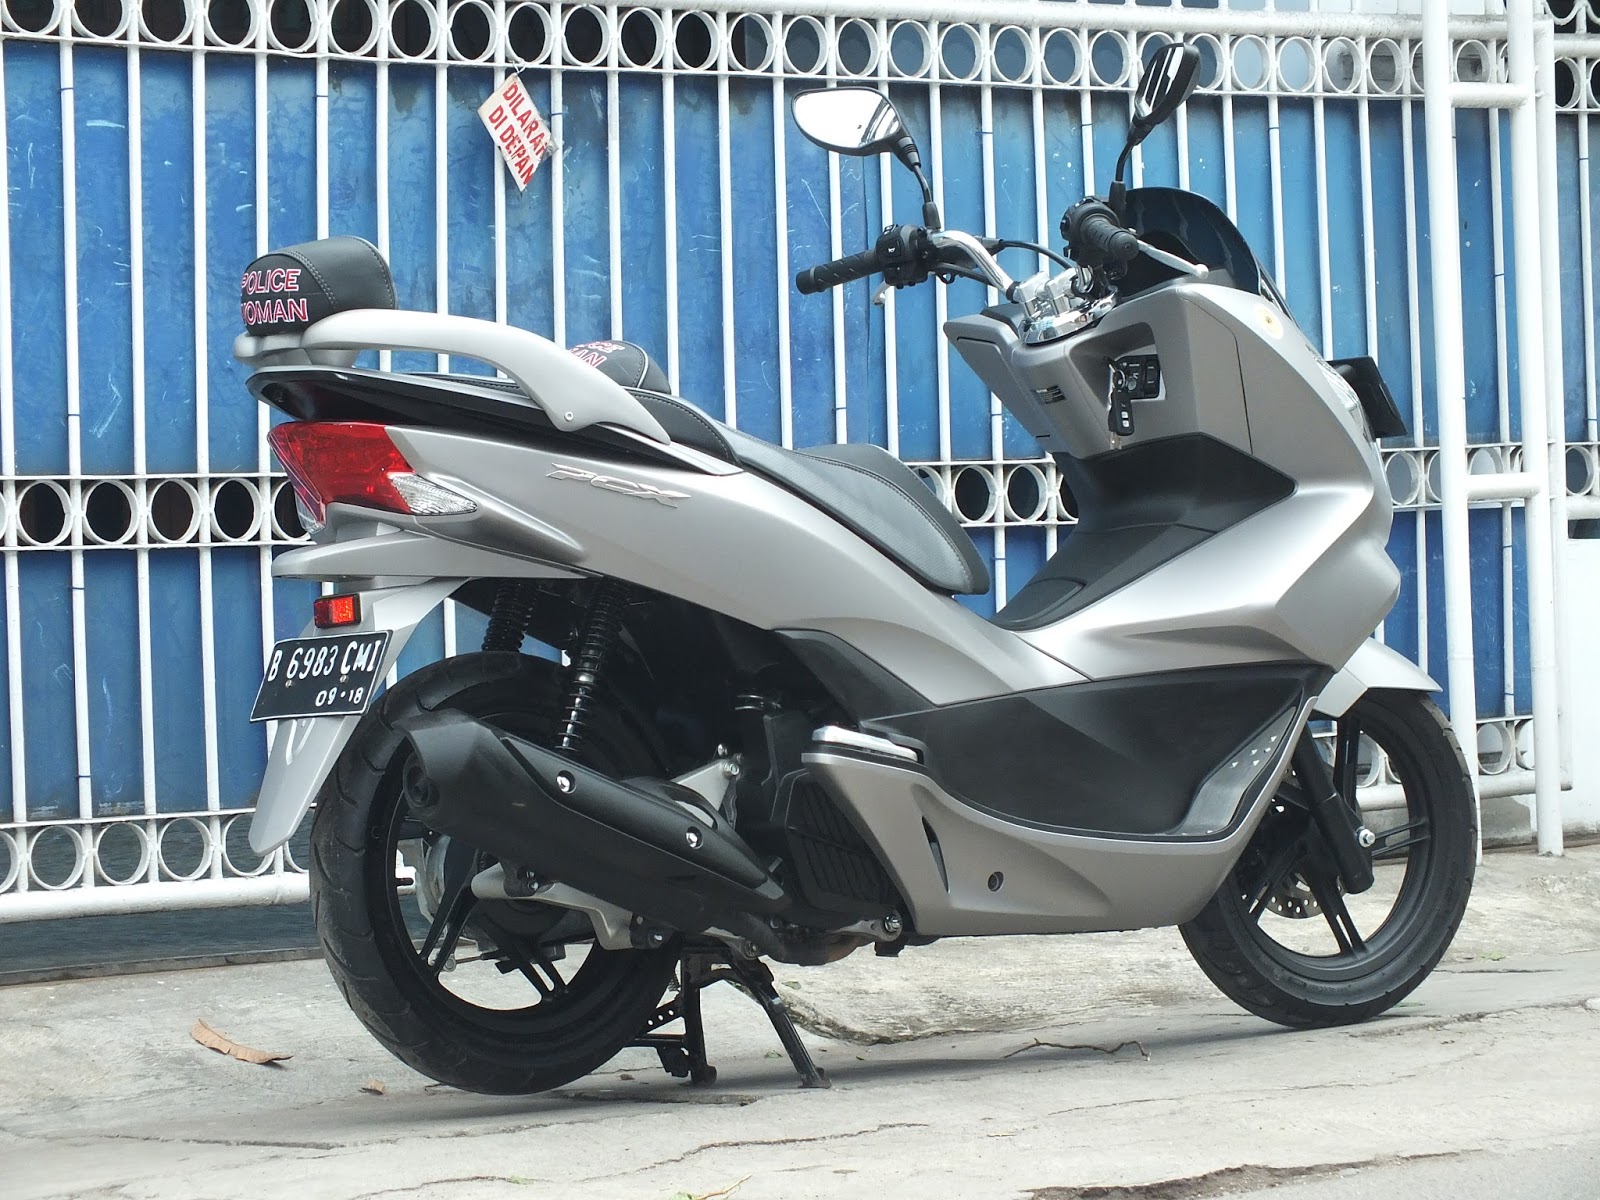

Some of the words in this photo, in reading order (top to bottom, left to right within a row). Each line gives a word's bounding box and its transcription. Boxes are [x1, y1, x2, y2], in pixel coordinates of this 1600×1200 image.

[488, 104, 508, 130] DI
[499, 124, 535, 185] DEPAN
[241, 267, 301, 295] POLICE
[545, 462, 692, 508] PCX
[267, 649, 283, 682] B
[286, 645, 339, 680] 6983
